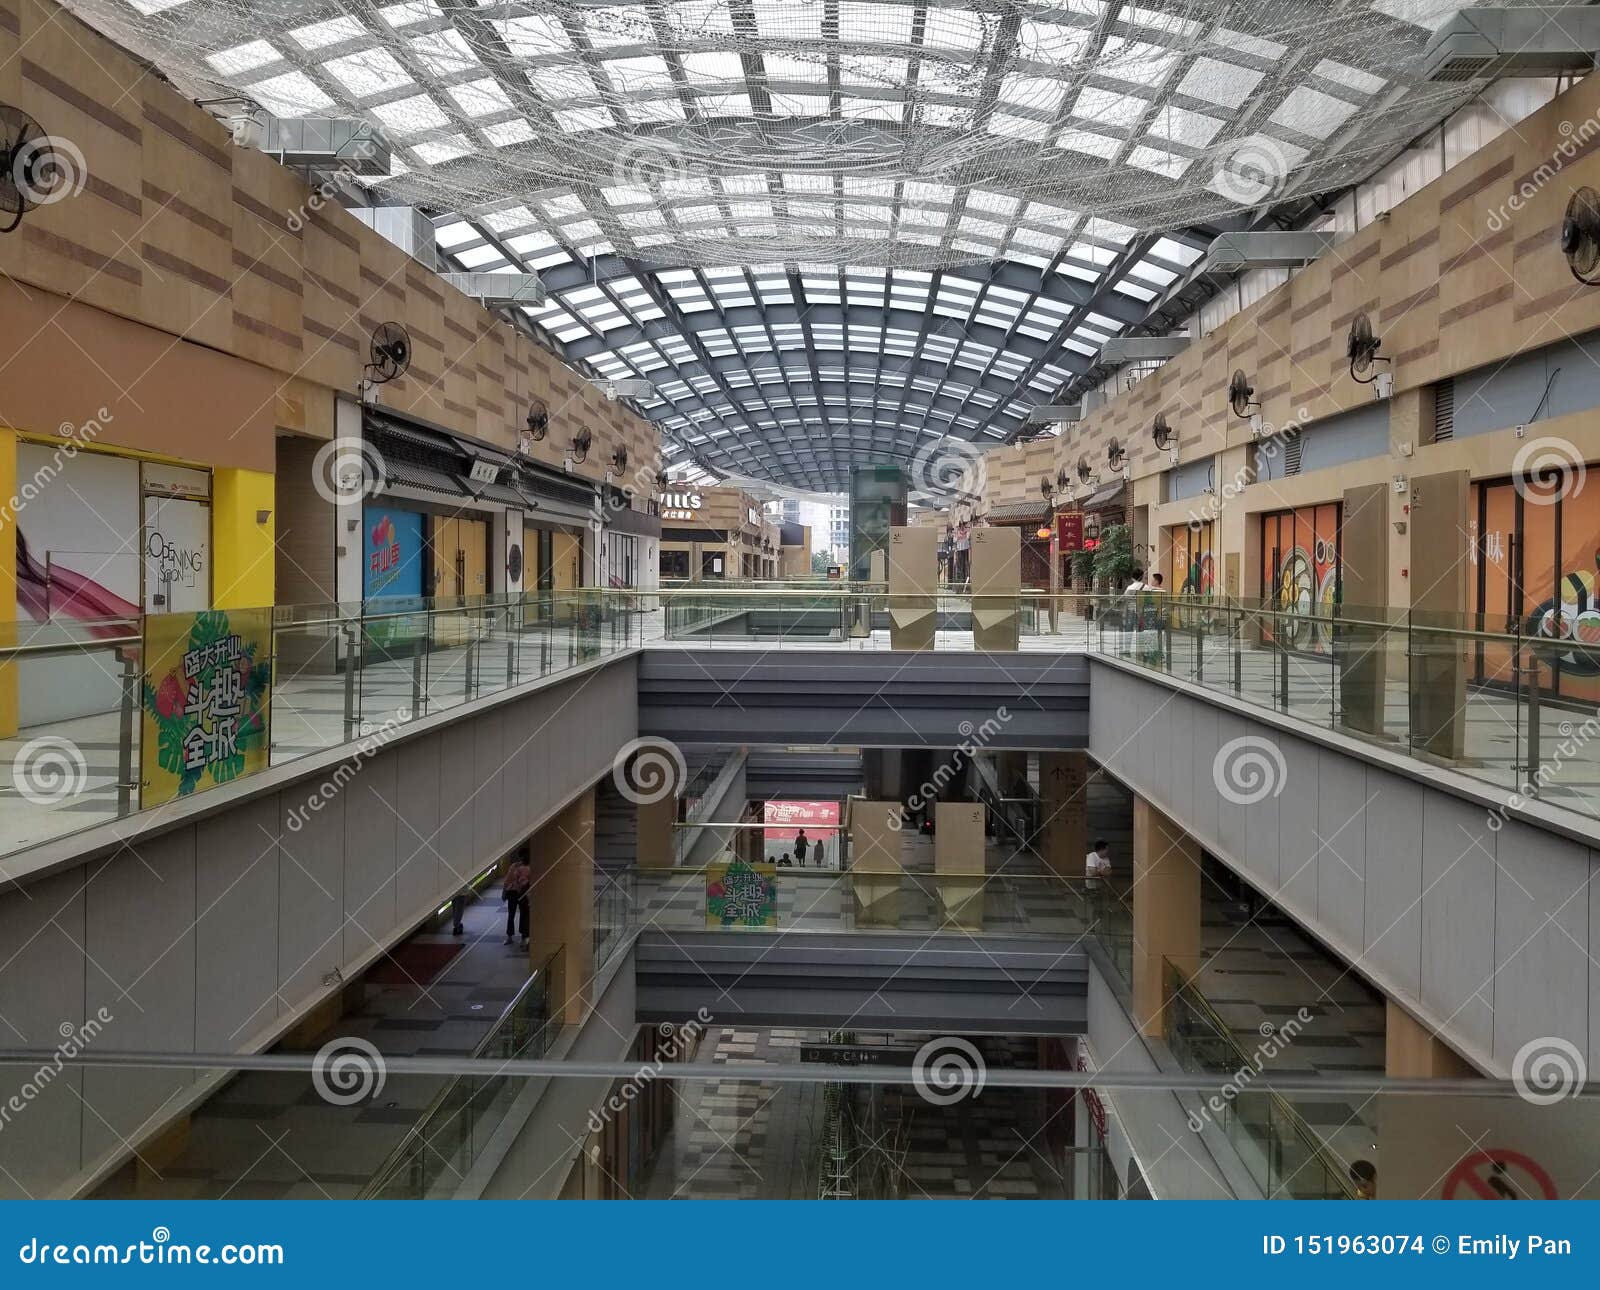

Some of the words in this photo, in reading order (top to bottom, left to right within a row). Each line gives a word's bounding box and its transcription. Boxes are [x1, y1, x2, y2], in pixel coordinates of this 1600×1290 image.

[149, 532, 202, 572] OPENING
[160, 565, 184, 583] SOON
[184, 717, 236, 771] 全城
